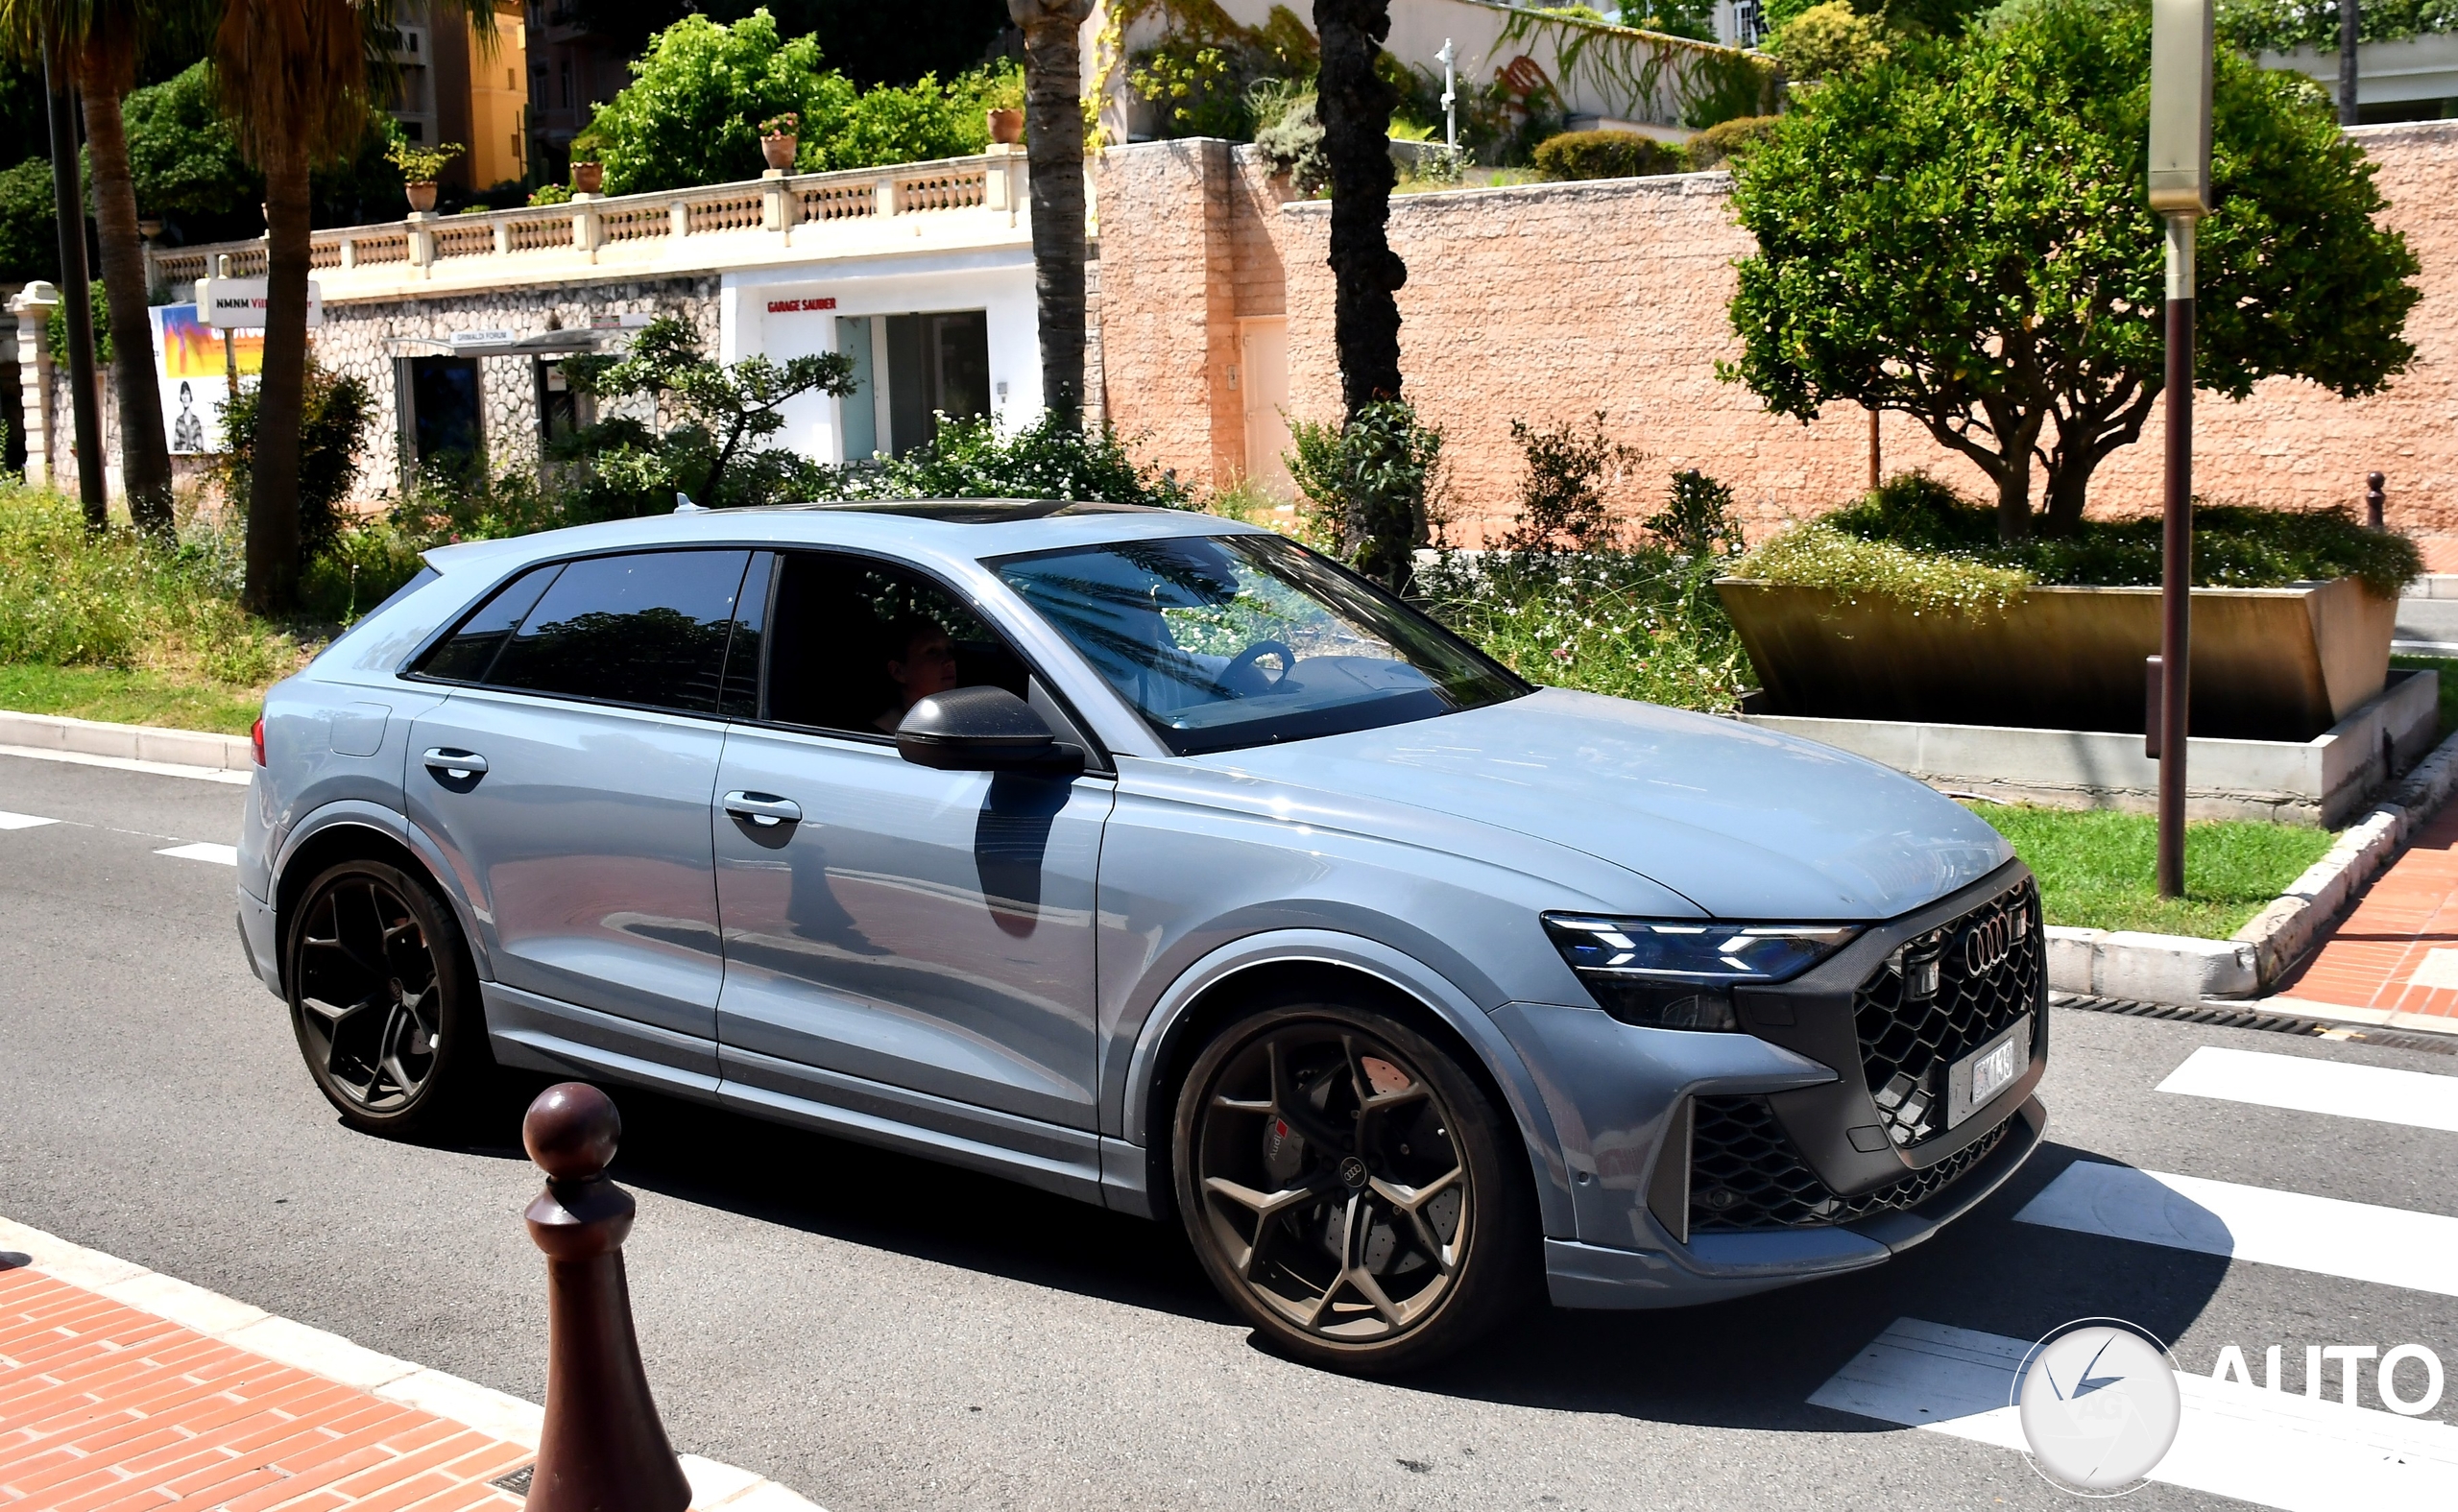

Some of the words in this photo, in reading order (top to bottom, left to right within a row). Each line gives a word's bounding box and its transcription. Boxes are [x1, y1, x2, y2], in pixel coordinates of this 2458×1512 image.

[216, 299, 250, 308] NMNM
[251, 299, 268, 308] Vill
[767, 300, 800, 313] GARAGE
[802, 298, 836, 310] SAUBER
[1269, 1134, 1282, 1161] Audi
